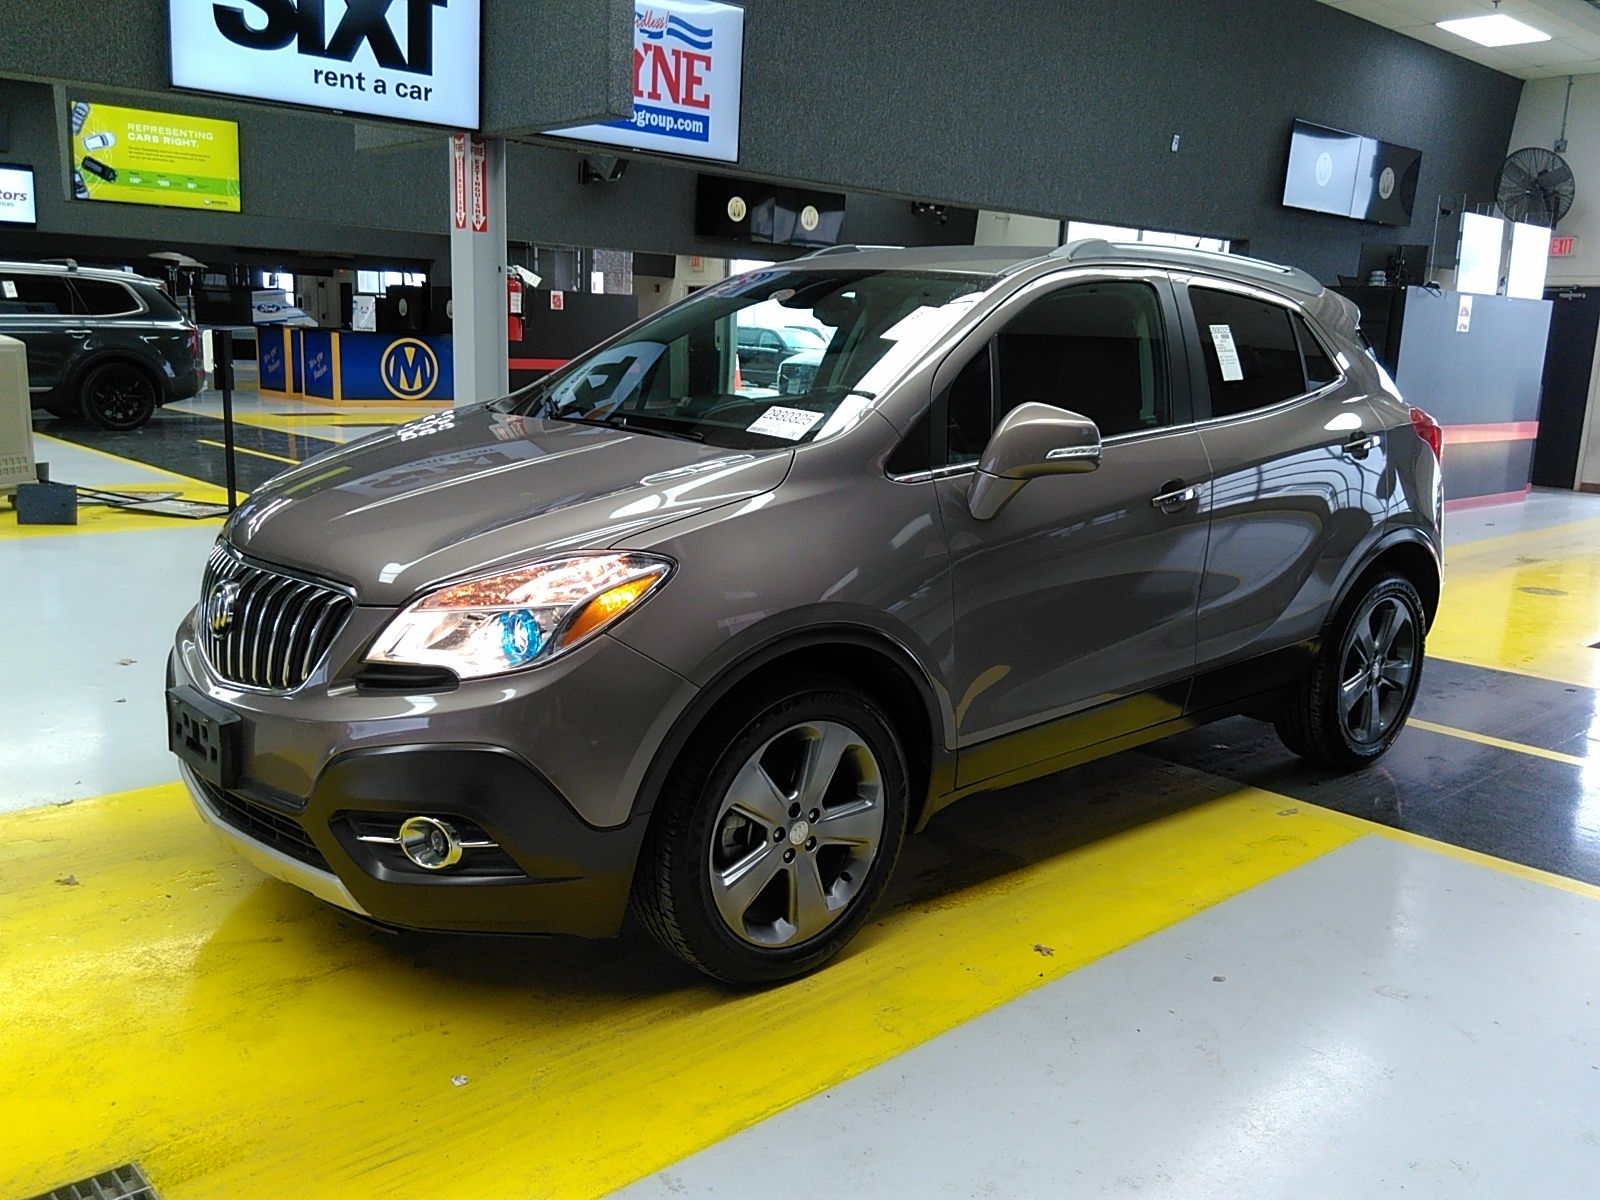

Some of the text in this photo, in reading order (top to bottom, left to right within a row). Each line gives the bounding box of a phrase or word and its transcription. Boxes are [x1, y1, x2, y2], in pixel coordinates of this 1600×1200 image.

[212, 0, 448, 76] SIXT
[633, 41, 712, 110] YNE
[313, 69, 433, 102] rent a car
[630, 109, 704, 134] ogroup.com
[127, 123, 214, 141] REPRESENTING
[127, 132, 160, 144] CARS
[471, 147, 485, 157] FIRE
[1551, 238, 1575, 255] EXIT
[762, 408, 816, 426] 2930325
